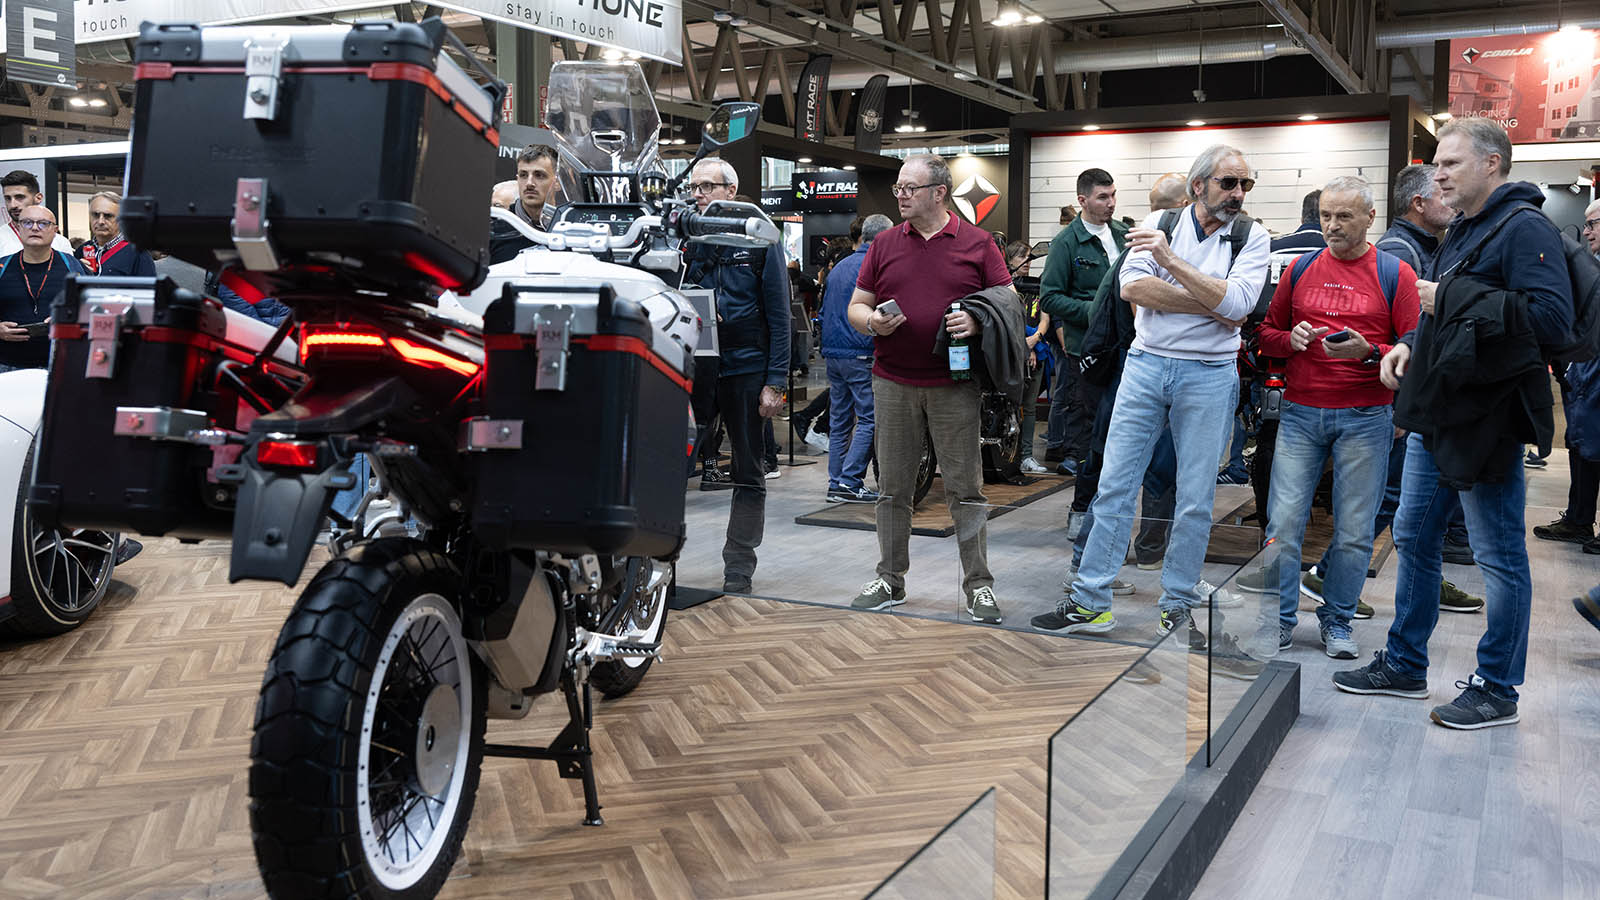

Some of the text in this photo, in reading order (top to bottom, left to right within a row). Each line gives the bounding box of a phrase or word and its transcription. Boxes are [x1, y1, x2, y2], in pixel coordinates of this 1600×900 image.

[83, 15, 128, 33] touch
[506, 3, 615, 40] stay in touch
[807, 74, 818, 131] MT RACE
[1464, 107, 1509, 119] RACING
[816, 183, 834, 192] MT
[1303, 287, 1370, 314] UNION
